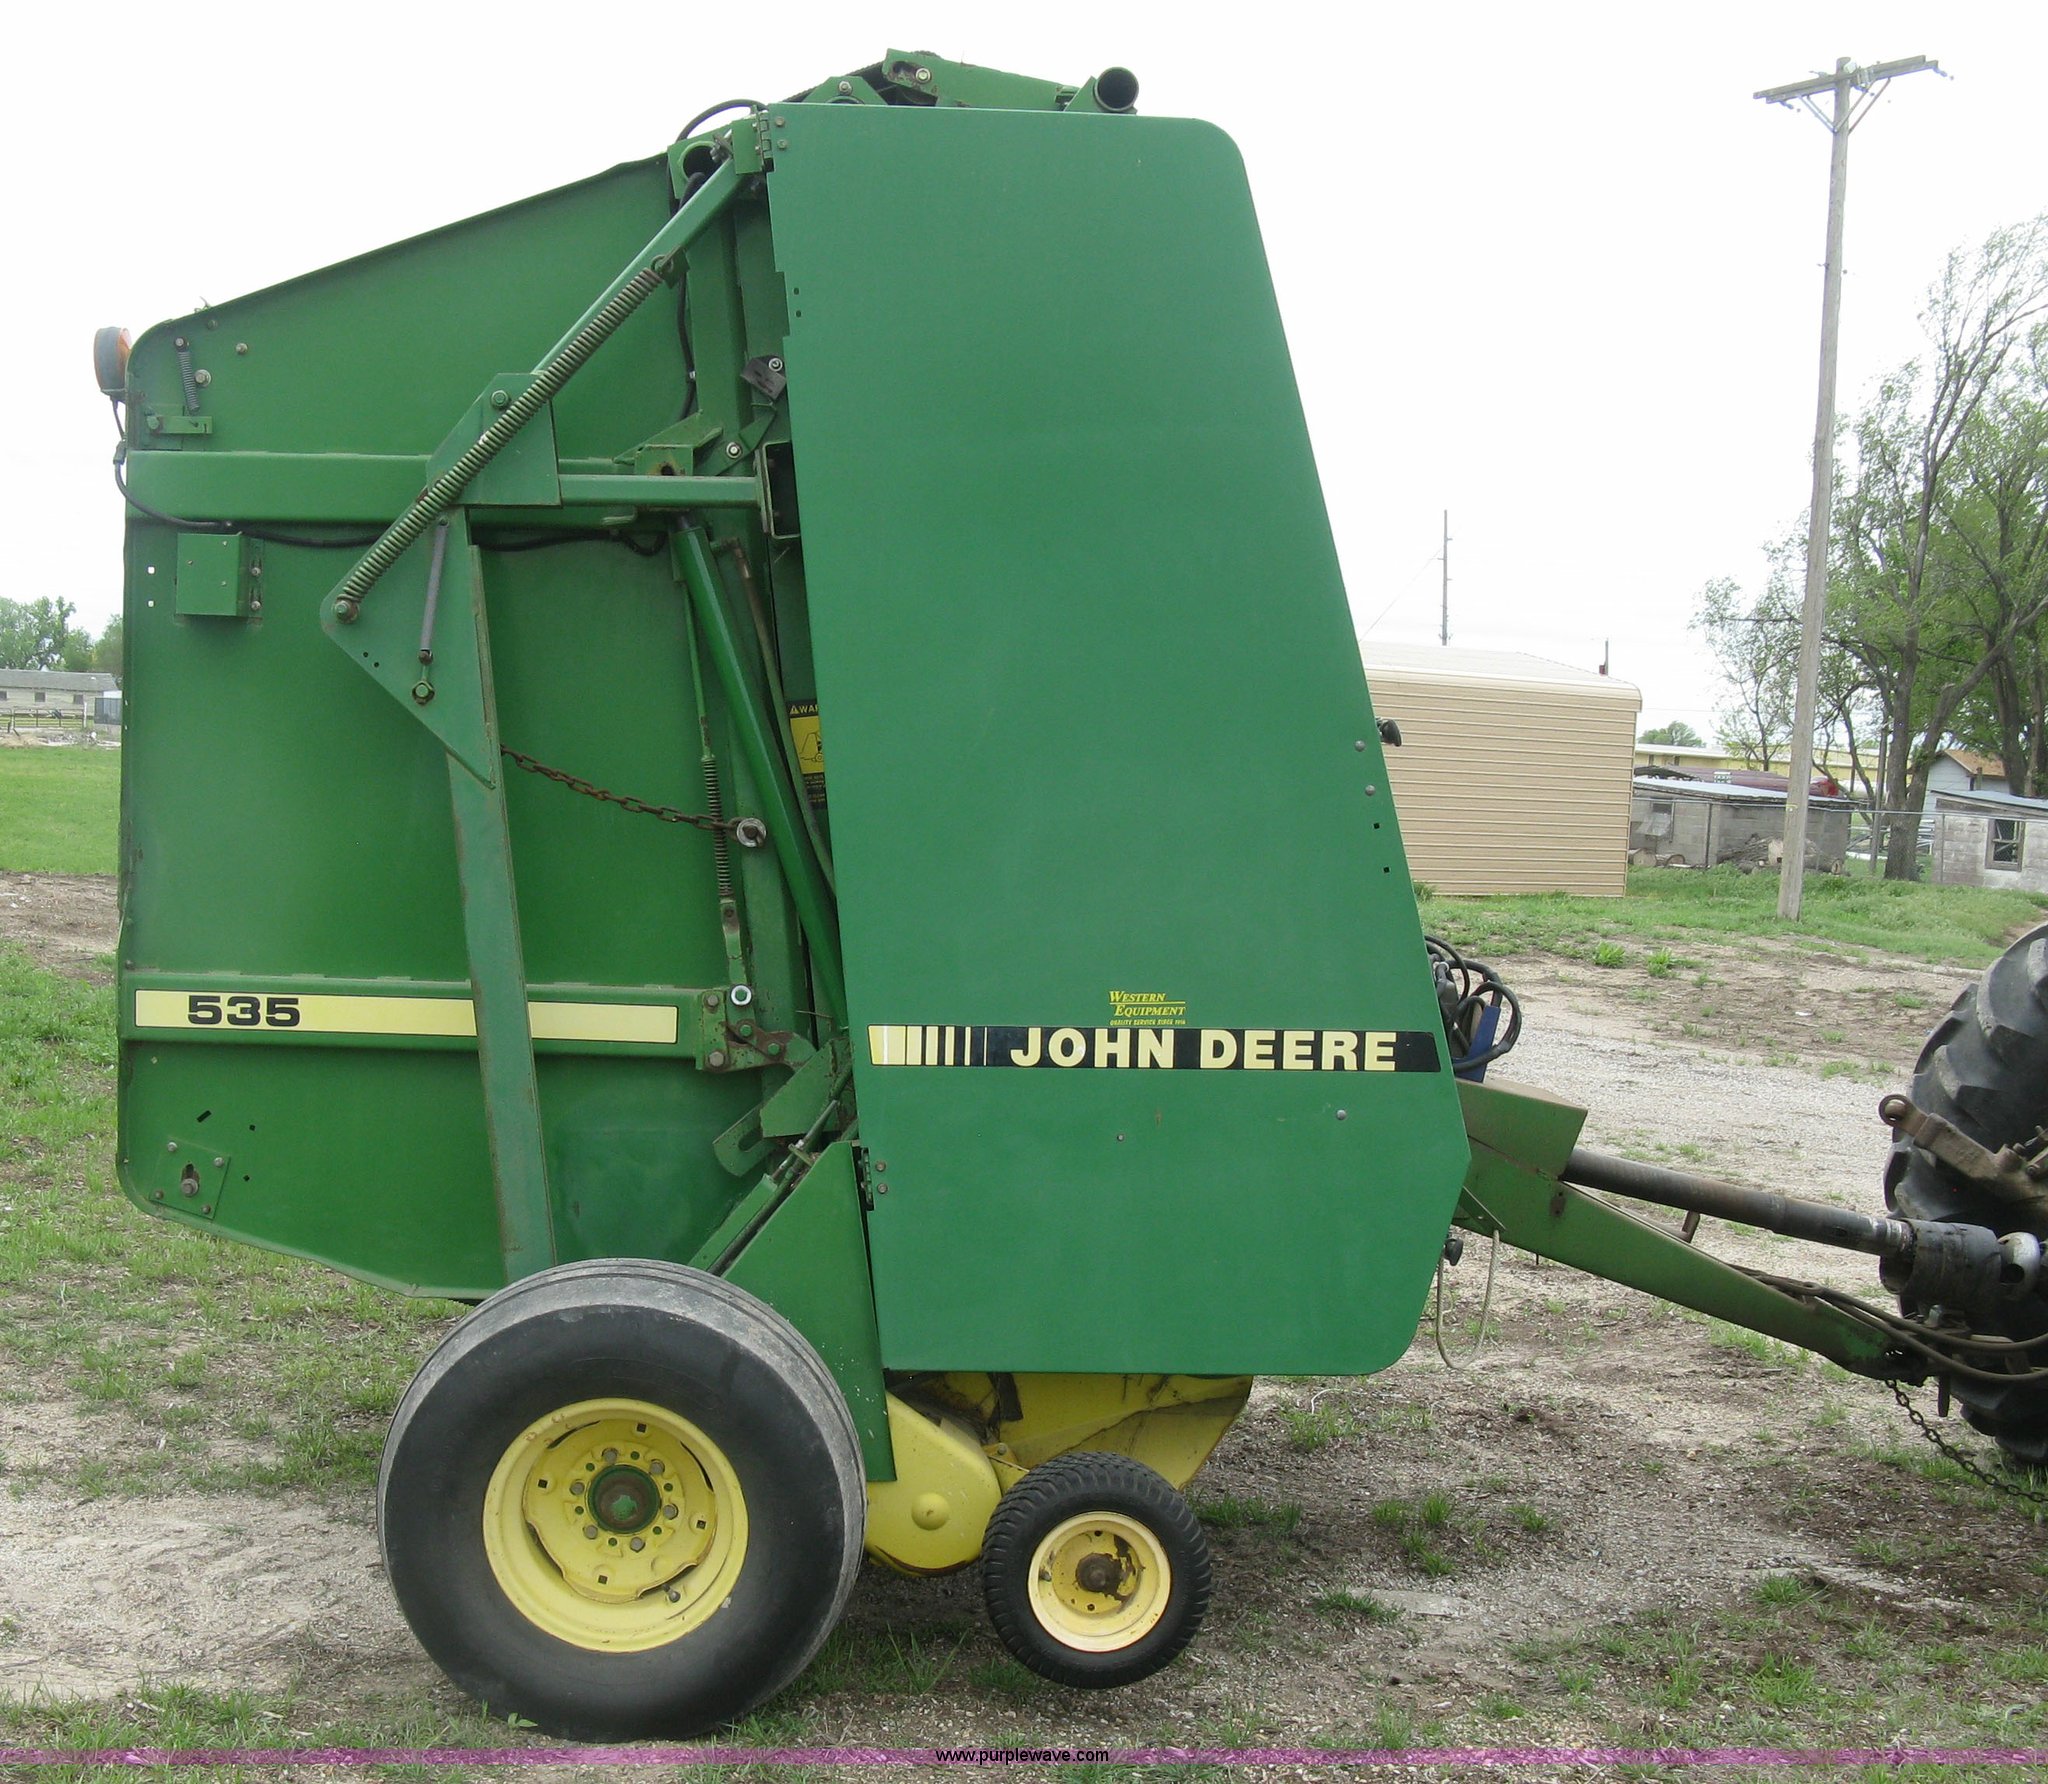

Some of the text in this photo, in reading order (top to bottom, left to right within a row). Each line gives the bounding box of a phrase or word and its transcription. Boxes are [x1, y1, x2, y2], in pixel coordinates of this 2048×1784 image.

[1109, 990, 1166, 1002] WESTERN
[188, 995, 300, 1027] 535
[1114, 1004, 1186, 1017] EQUIPMENT
[1010, 1027, 1398, 1072] JOHN DEERE
